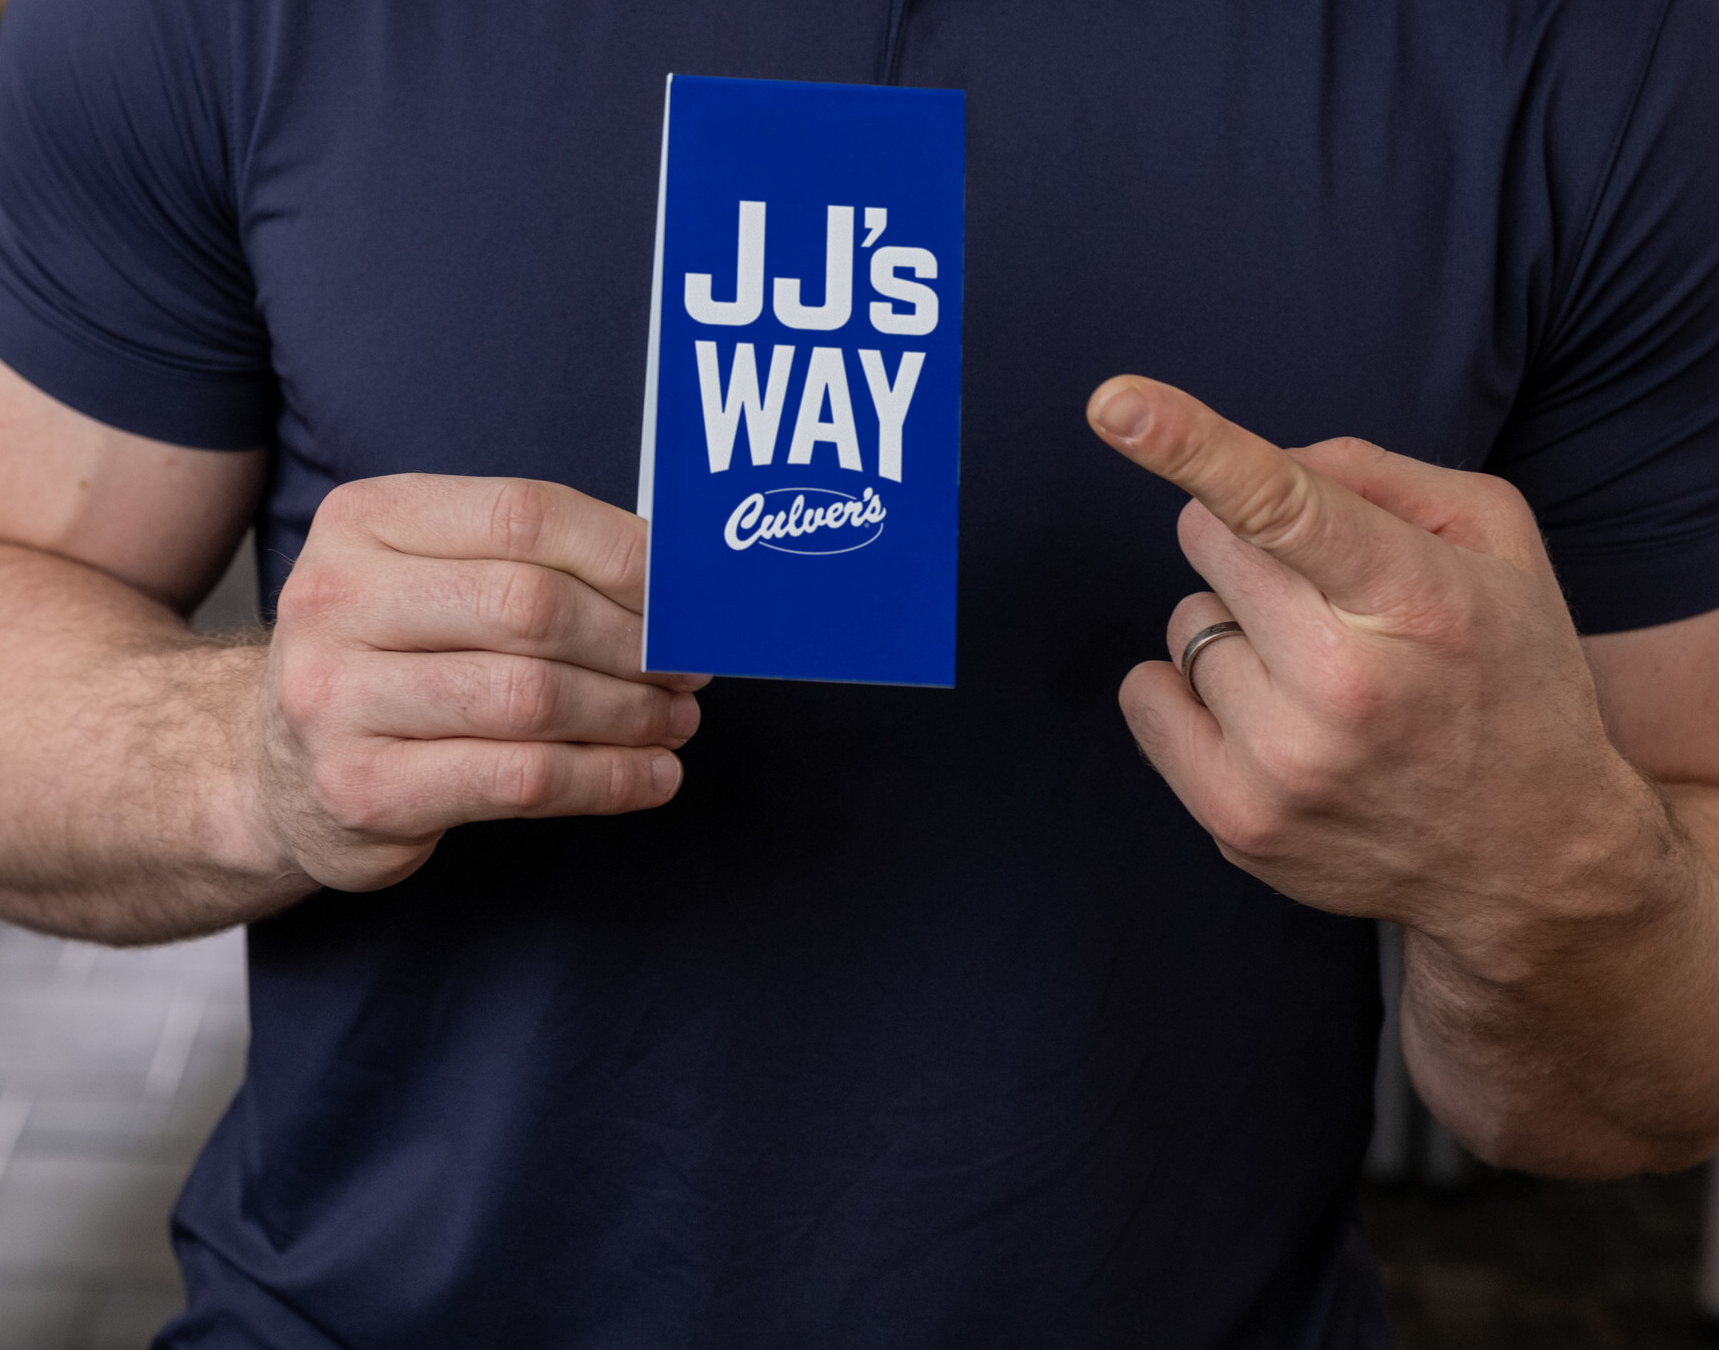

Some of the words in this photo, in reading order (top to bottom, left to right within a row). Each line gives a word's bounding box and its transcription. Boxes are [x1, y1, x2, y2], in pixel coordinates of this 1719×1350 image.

[684, 200, 939, 336] JJ's
[694, 340, 927, 483] WAY
[724, 487, 887, 551] Culver's
